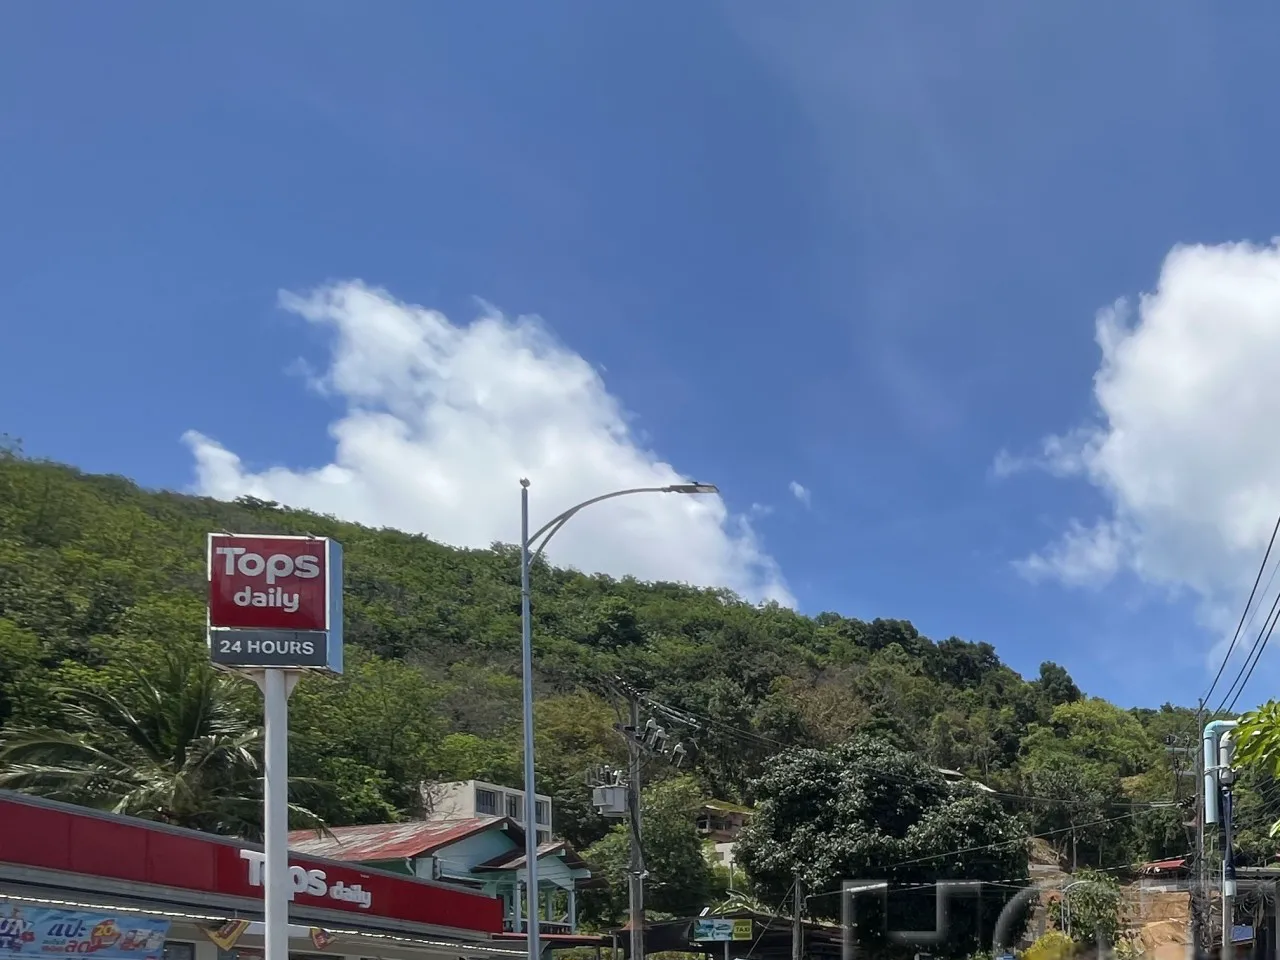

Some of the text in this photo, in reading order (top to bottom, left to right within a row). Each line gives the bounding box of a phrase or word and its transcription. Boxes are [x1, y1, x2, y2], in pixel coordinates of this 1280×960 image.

[216, 547, 320, 585] Tops
[234, 586, 299, 613] daily
[220, 640, 315, 655] 24 HOURS
[240, 849, 371, 908] Tps daily
